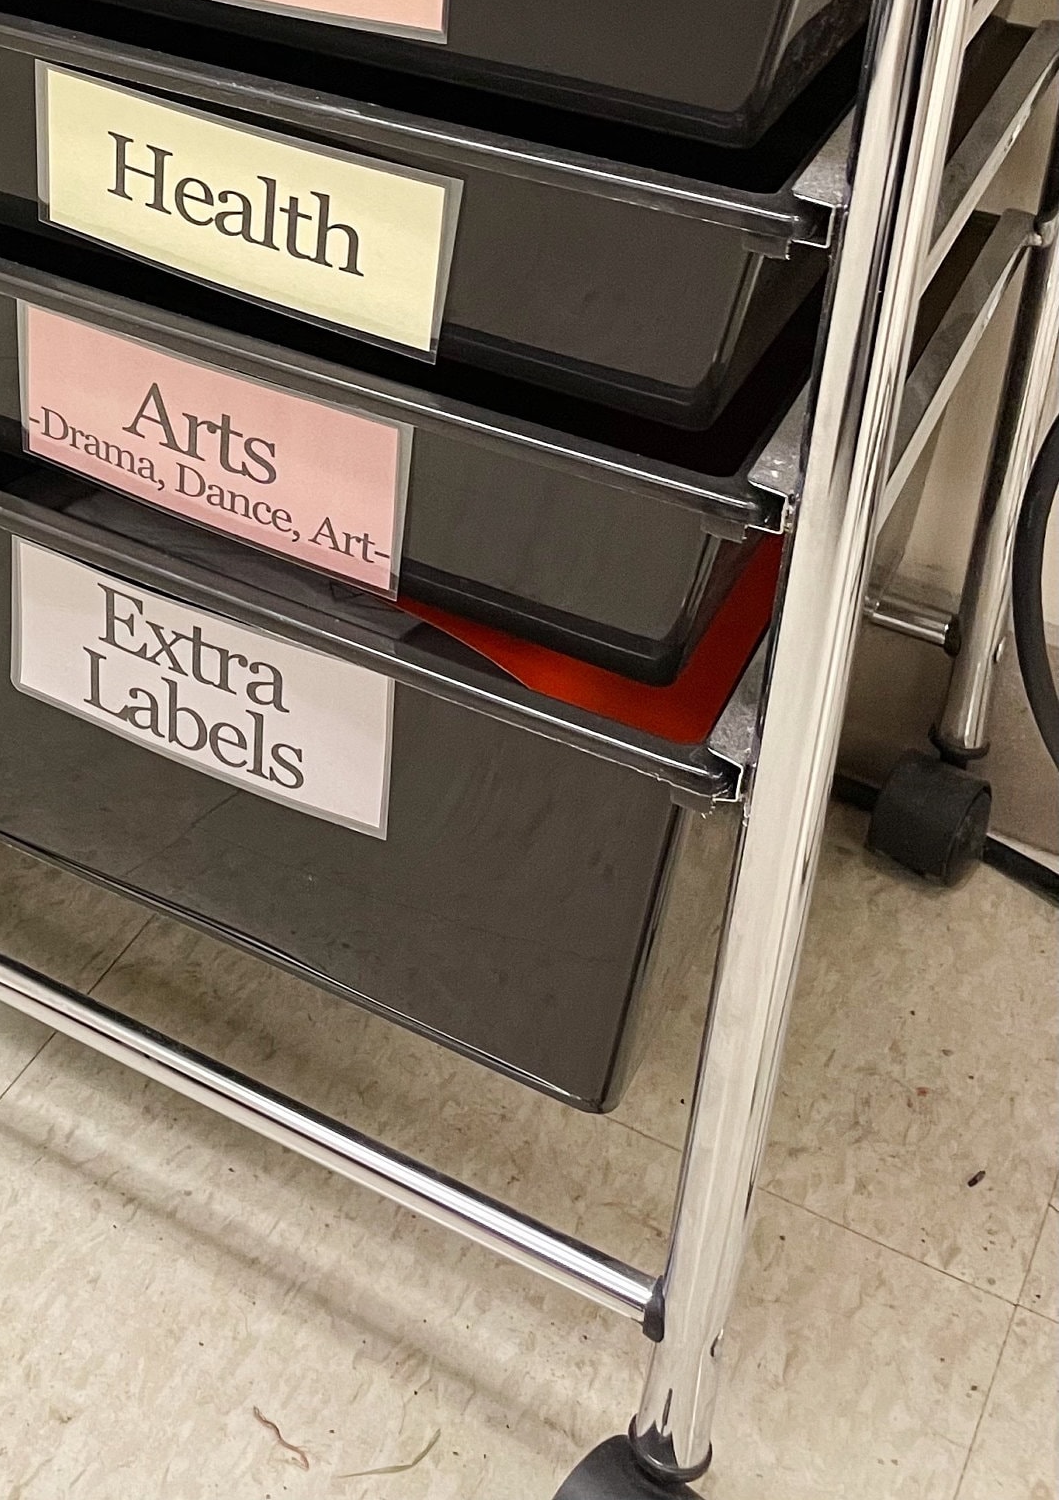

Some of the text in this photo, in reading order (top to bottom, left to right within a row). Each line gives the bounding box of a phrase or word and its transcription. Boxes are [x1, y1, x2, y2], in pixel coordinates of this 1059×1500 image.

[107, 130, 364, 277] Health
[28, 406, 391, 564] -Drama, Dance, Art-
[122, 382, 277, 485] Arts
[83, 646, 304, 789] Labels
[97, 582, 290, 714] Extra
